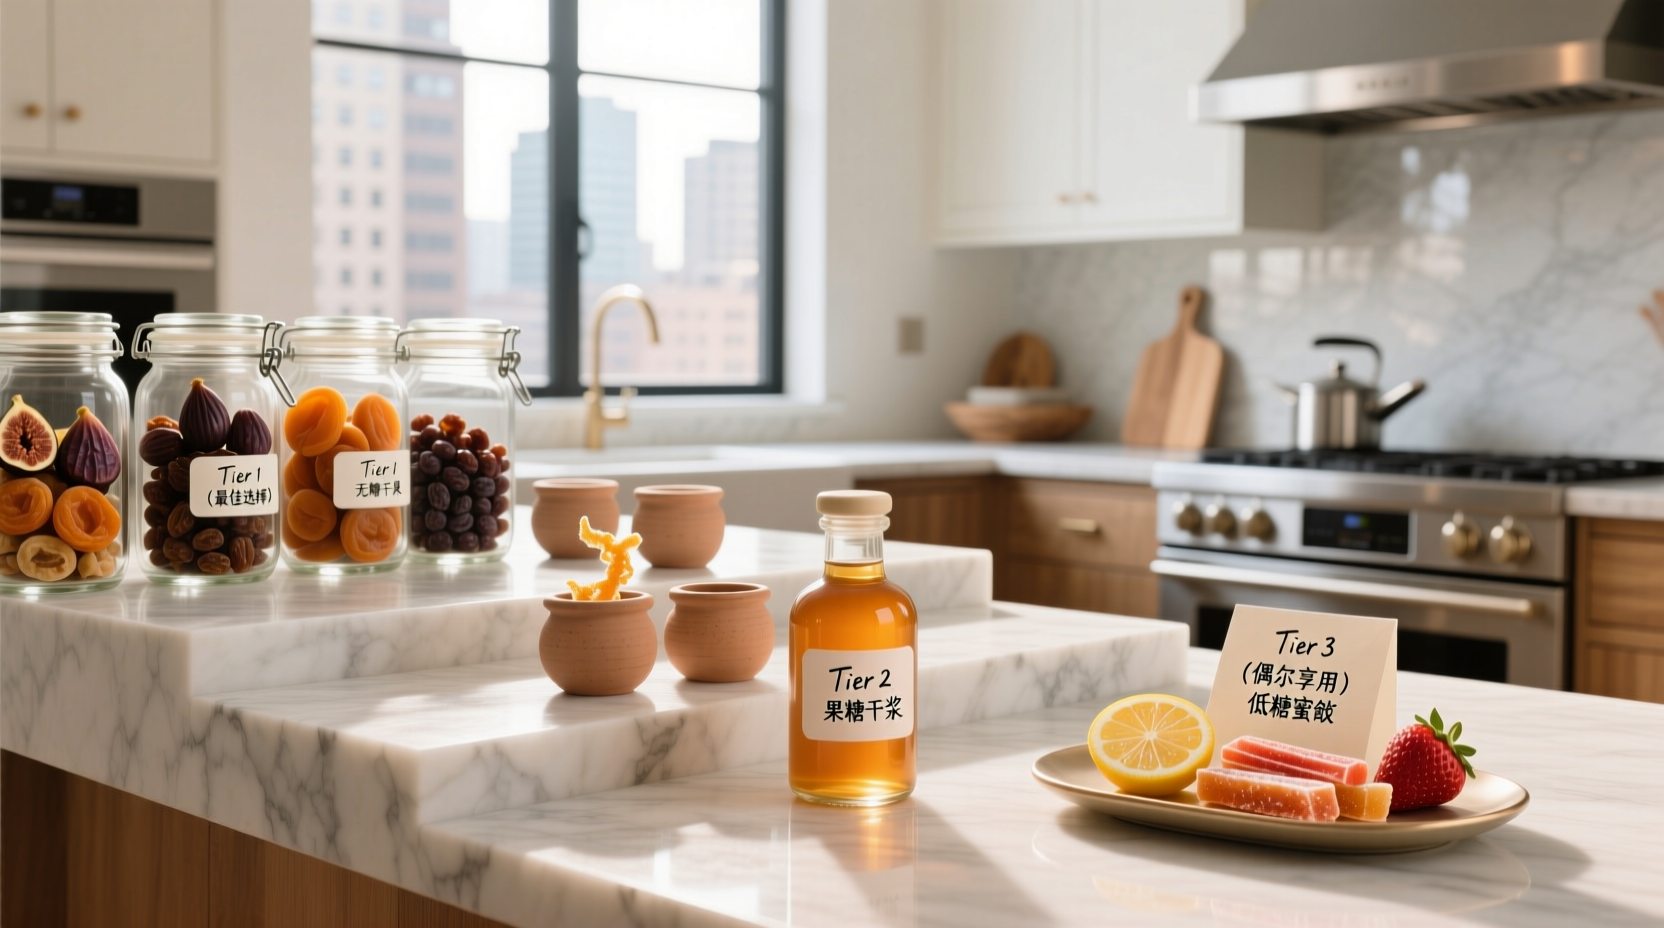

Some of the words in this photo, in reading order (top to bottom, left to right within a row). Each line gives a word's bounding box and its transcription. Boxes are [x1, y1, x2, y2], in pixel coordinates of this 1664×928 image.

[218, 465, 252, 485] Tier
[361, 460, 389, 478] Tier
[1276, 630, 1318, 655] Tier
[1321, 637, 1335, 657] 3
[829, 666, 874, 692] Tier
[879, 669, 891, 688] 2
[1243, 662, 1348, 695] （偶尔享用）
[823, 696, 903, 723] 果糖干浆
